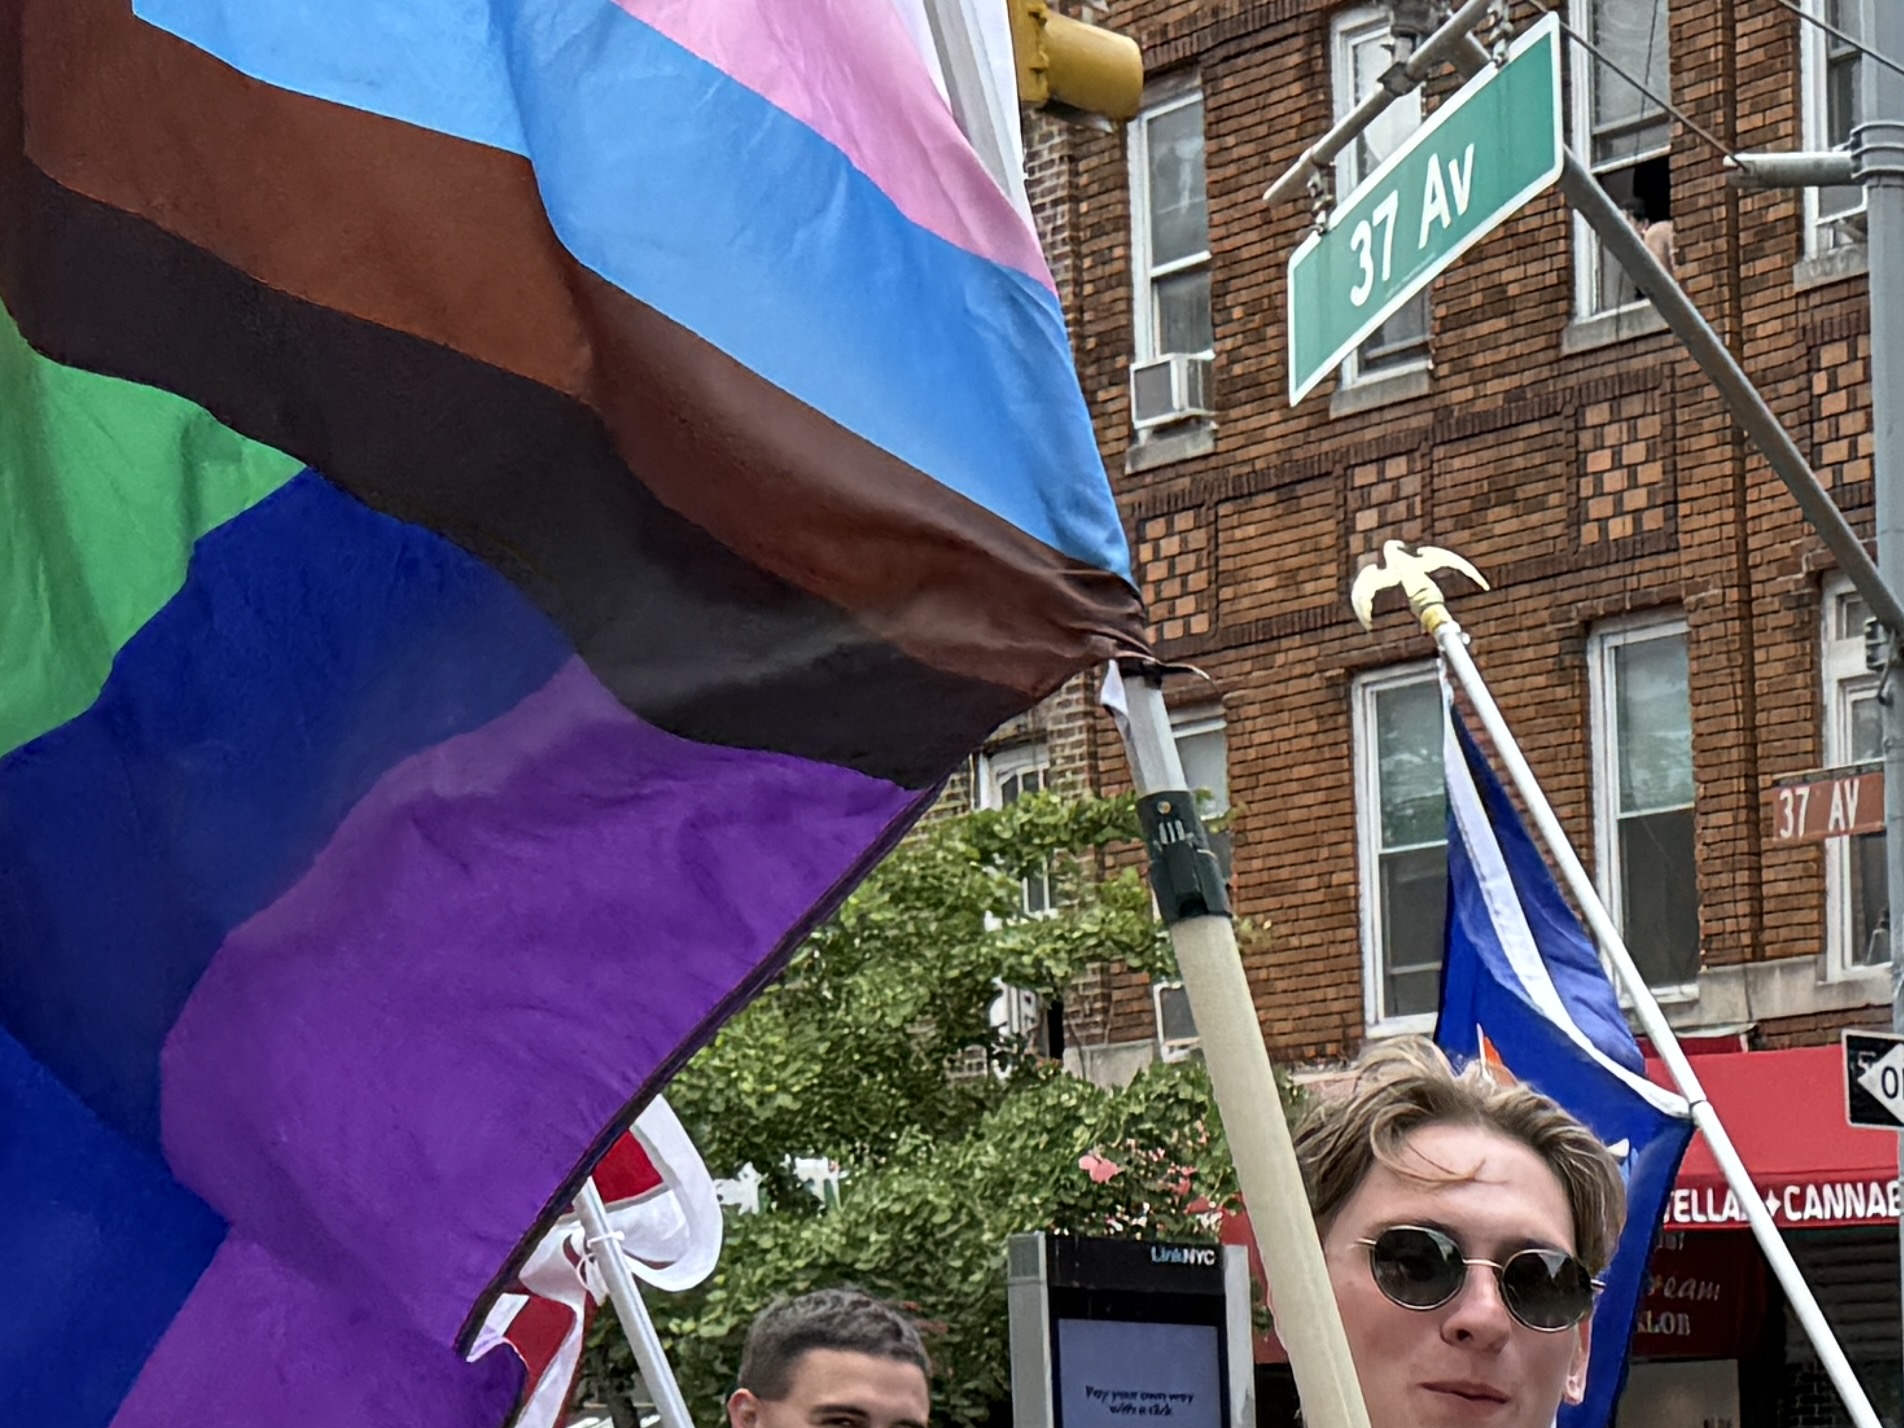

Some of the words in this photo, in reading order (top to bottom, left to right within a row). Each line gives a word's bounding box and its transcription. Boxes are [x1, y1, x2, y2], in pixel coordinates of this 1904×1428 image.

[1350, 190, 1399, 306] 37
[1419, 143, 1475, 249] Av
[1779, 786, 1809, 838] 37
[1828, 778, 1860, 832] AV
[1783, 1181, 1900, 1222] CANNAB
[1150, 1245, 1216, 1266] LinkNYC
